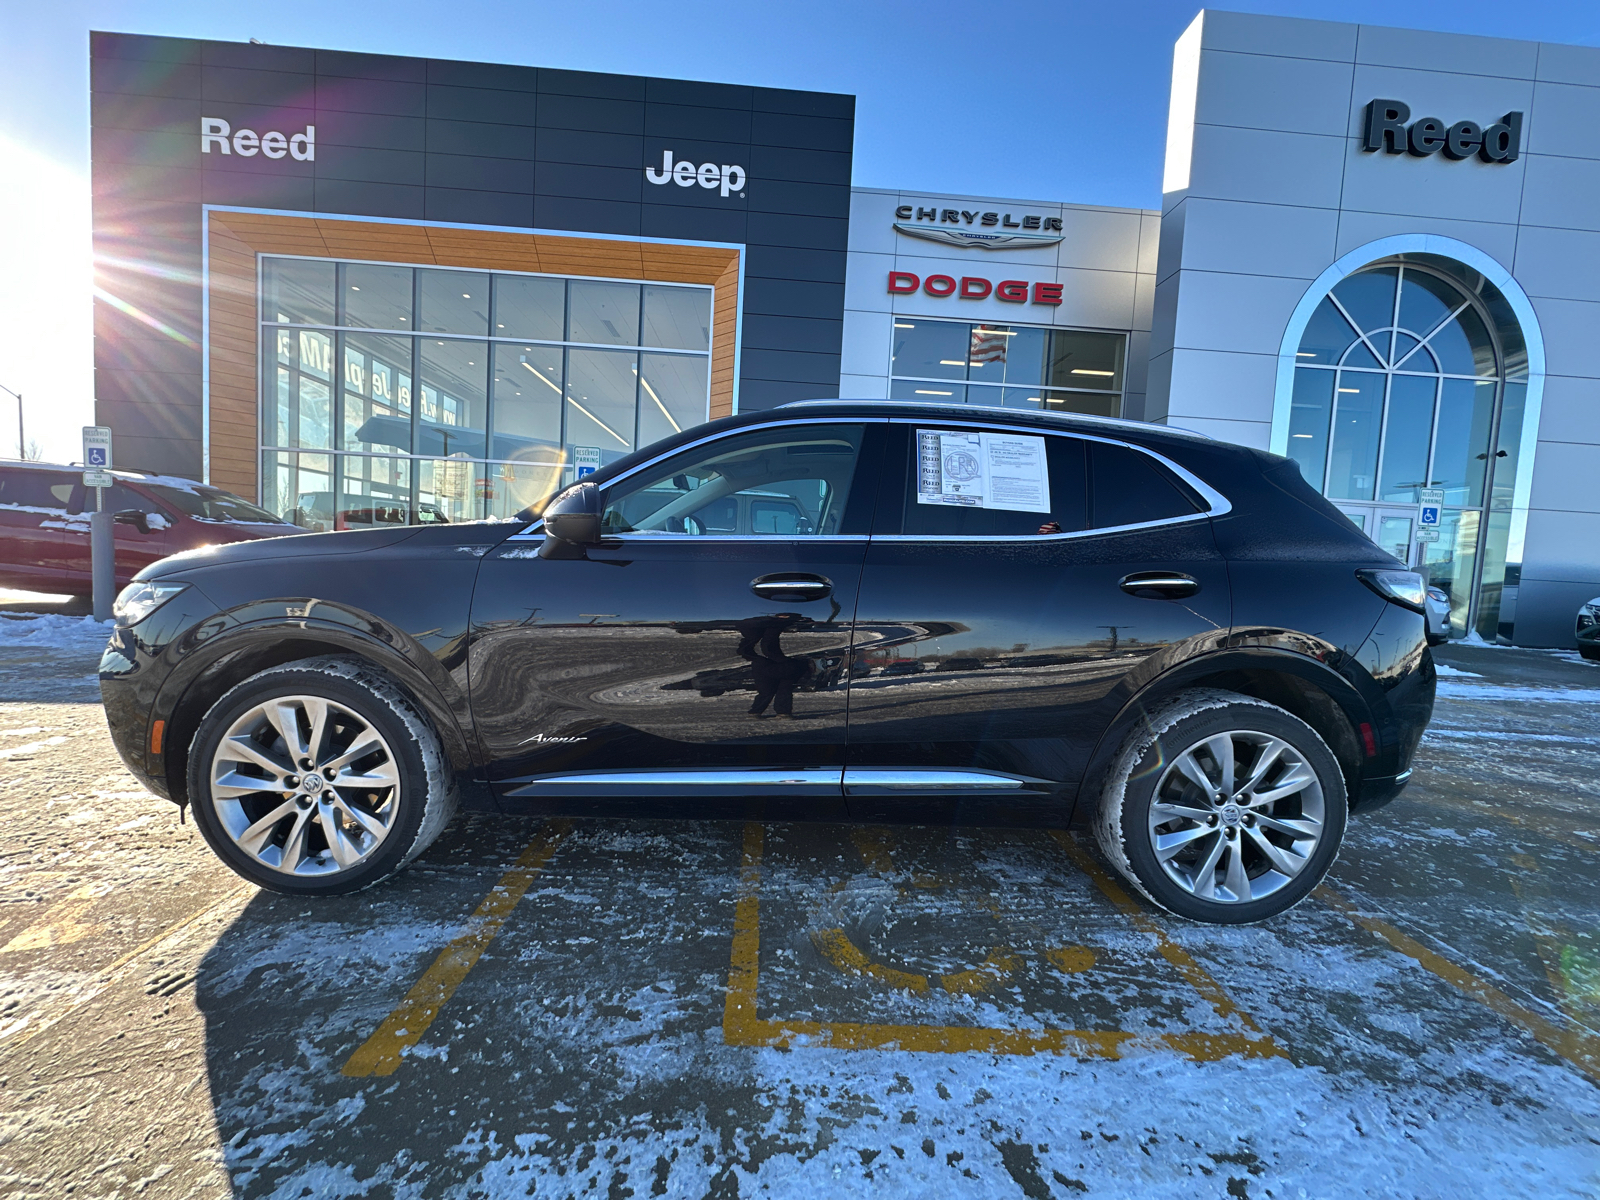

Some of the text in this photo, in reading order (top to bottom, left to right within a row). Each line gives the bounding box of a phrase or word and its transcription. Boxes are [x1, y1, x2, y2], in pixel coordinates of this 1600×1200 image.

[201, 116, 315, 162] Reed
[1363, 98, 1524, 165] Reed
[645, 150, 746, 198] Jeep
[895, 205, 1063, 231] CHRYSLER
[887, 271, 1064, 307] DODGE
[576, 449, 599, 457] RESERVED
[576, 456, 599, 464] PARKING
[518, 733, 588, 745] Avenir
